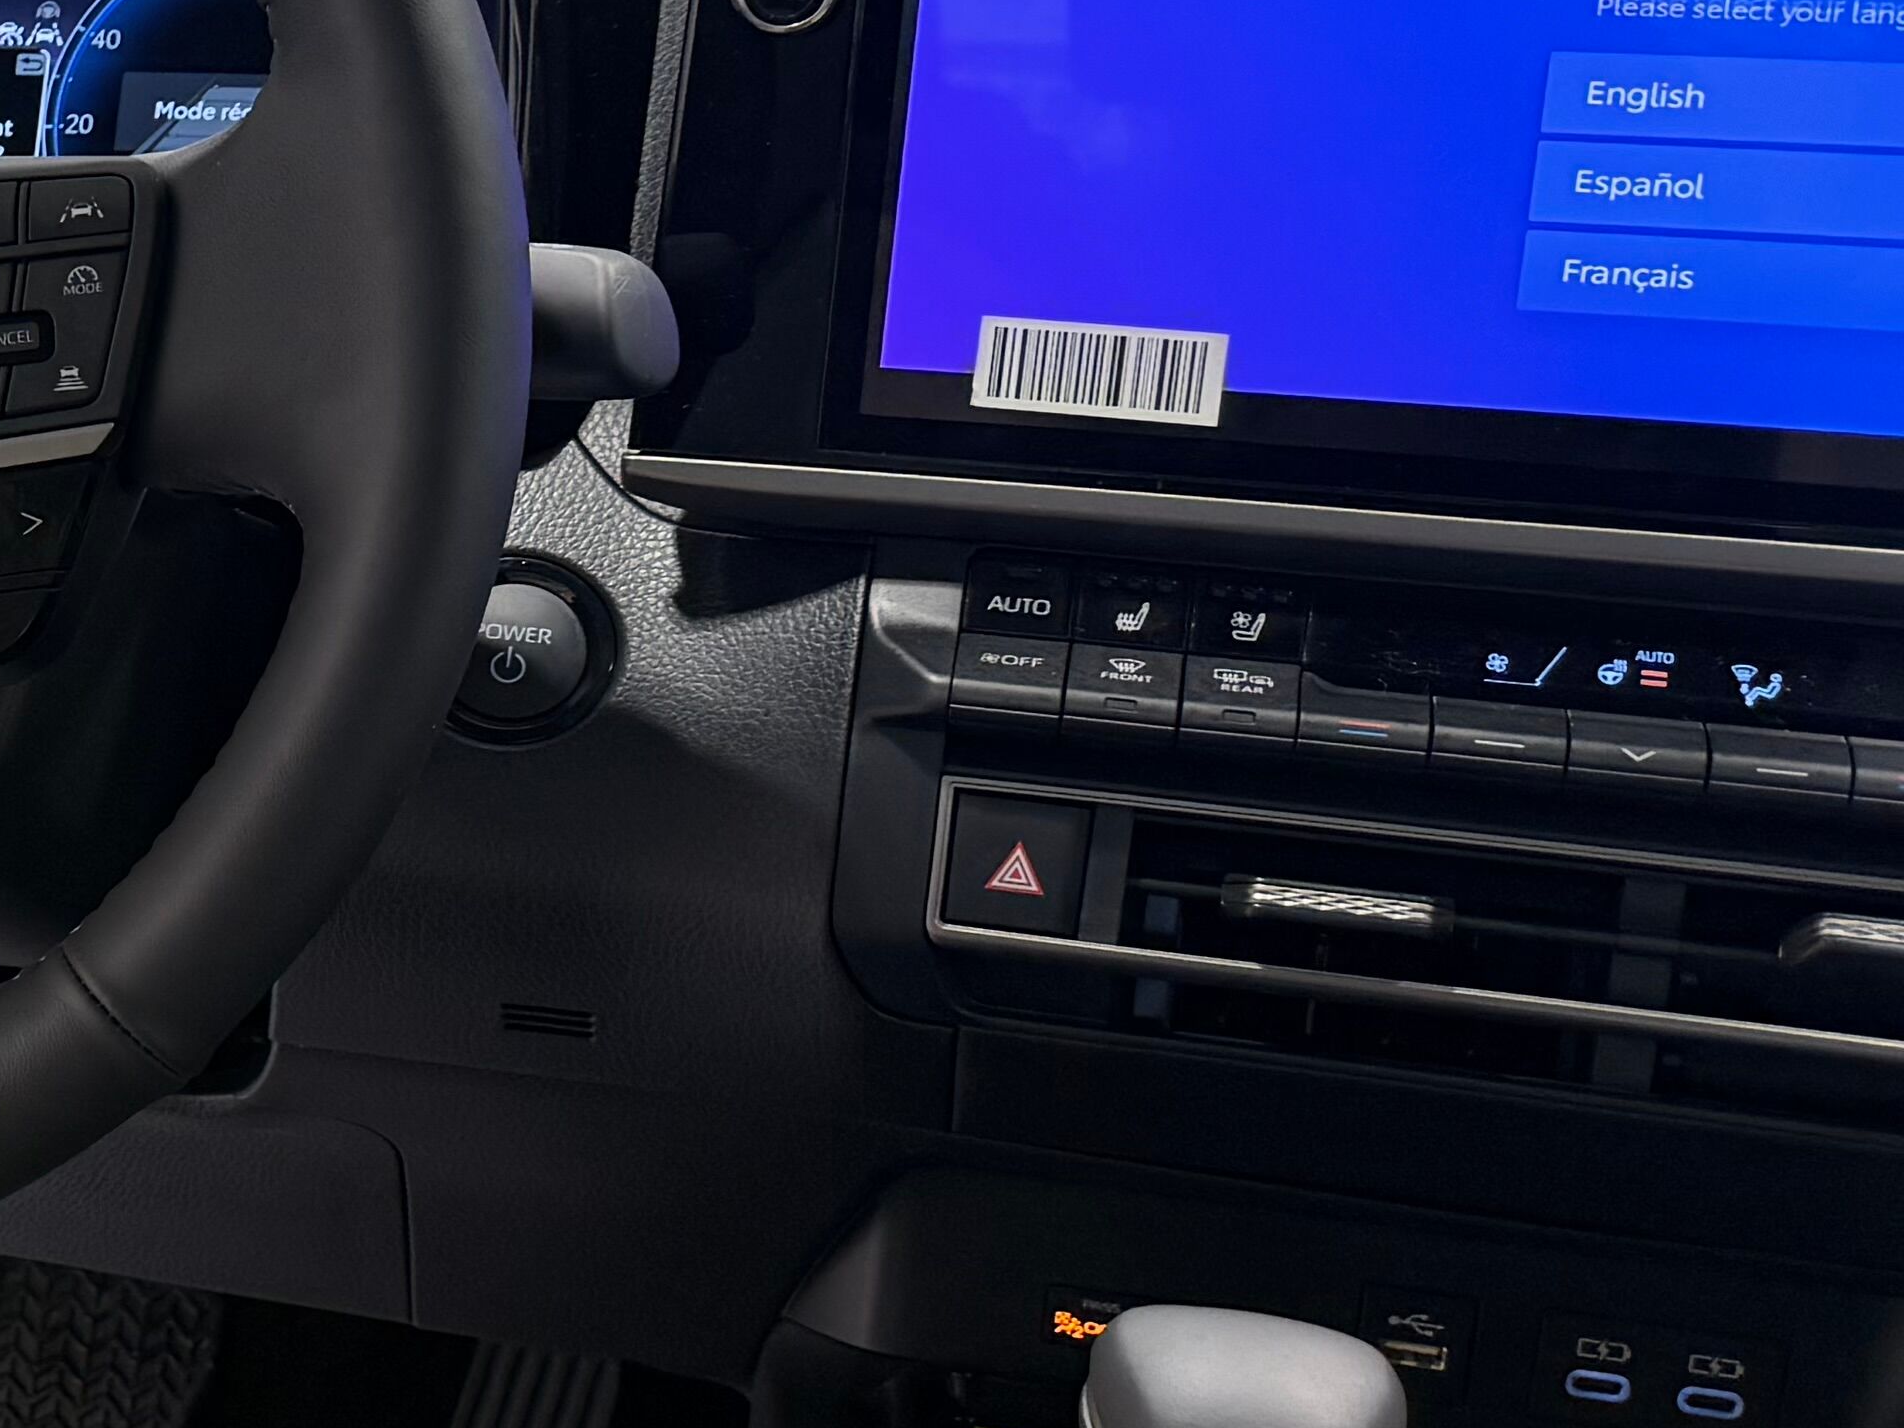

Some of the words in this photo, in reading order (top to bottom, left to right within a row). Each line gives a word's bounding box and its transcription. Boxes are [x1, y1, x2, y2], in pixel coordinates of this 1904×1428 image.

[1779, 0, 1846, 27] your
[91, 28, 122, 50] 40
[1586, 80, 1706, 114] English
[154, 100, 217, 121] Mode
[64, 114, 94, 135] 20
[1574, 169, 1705, 201] Español
[1562, 259, 1695, 293] Français
[63, 281, 104, 297] MODE
[986, 594, 1052, 616] AUTO
[1000, 654, 1045, 669] OFF
[1634, 649, 1676, 665] AUTO
[1099, 671, 1153, 684] FRONT
[1219, 683, 1264, 695] REAR
